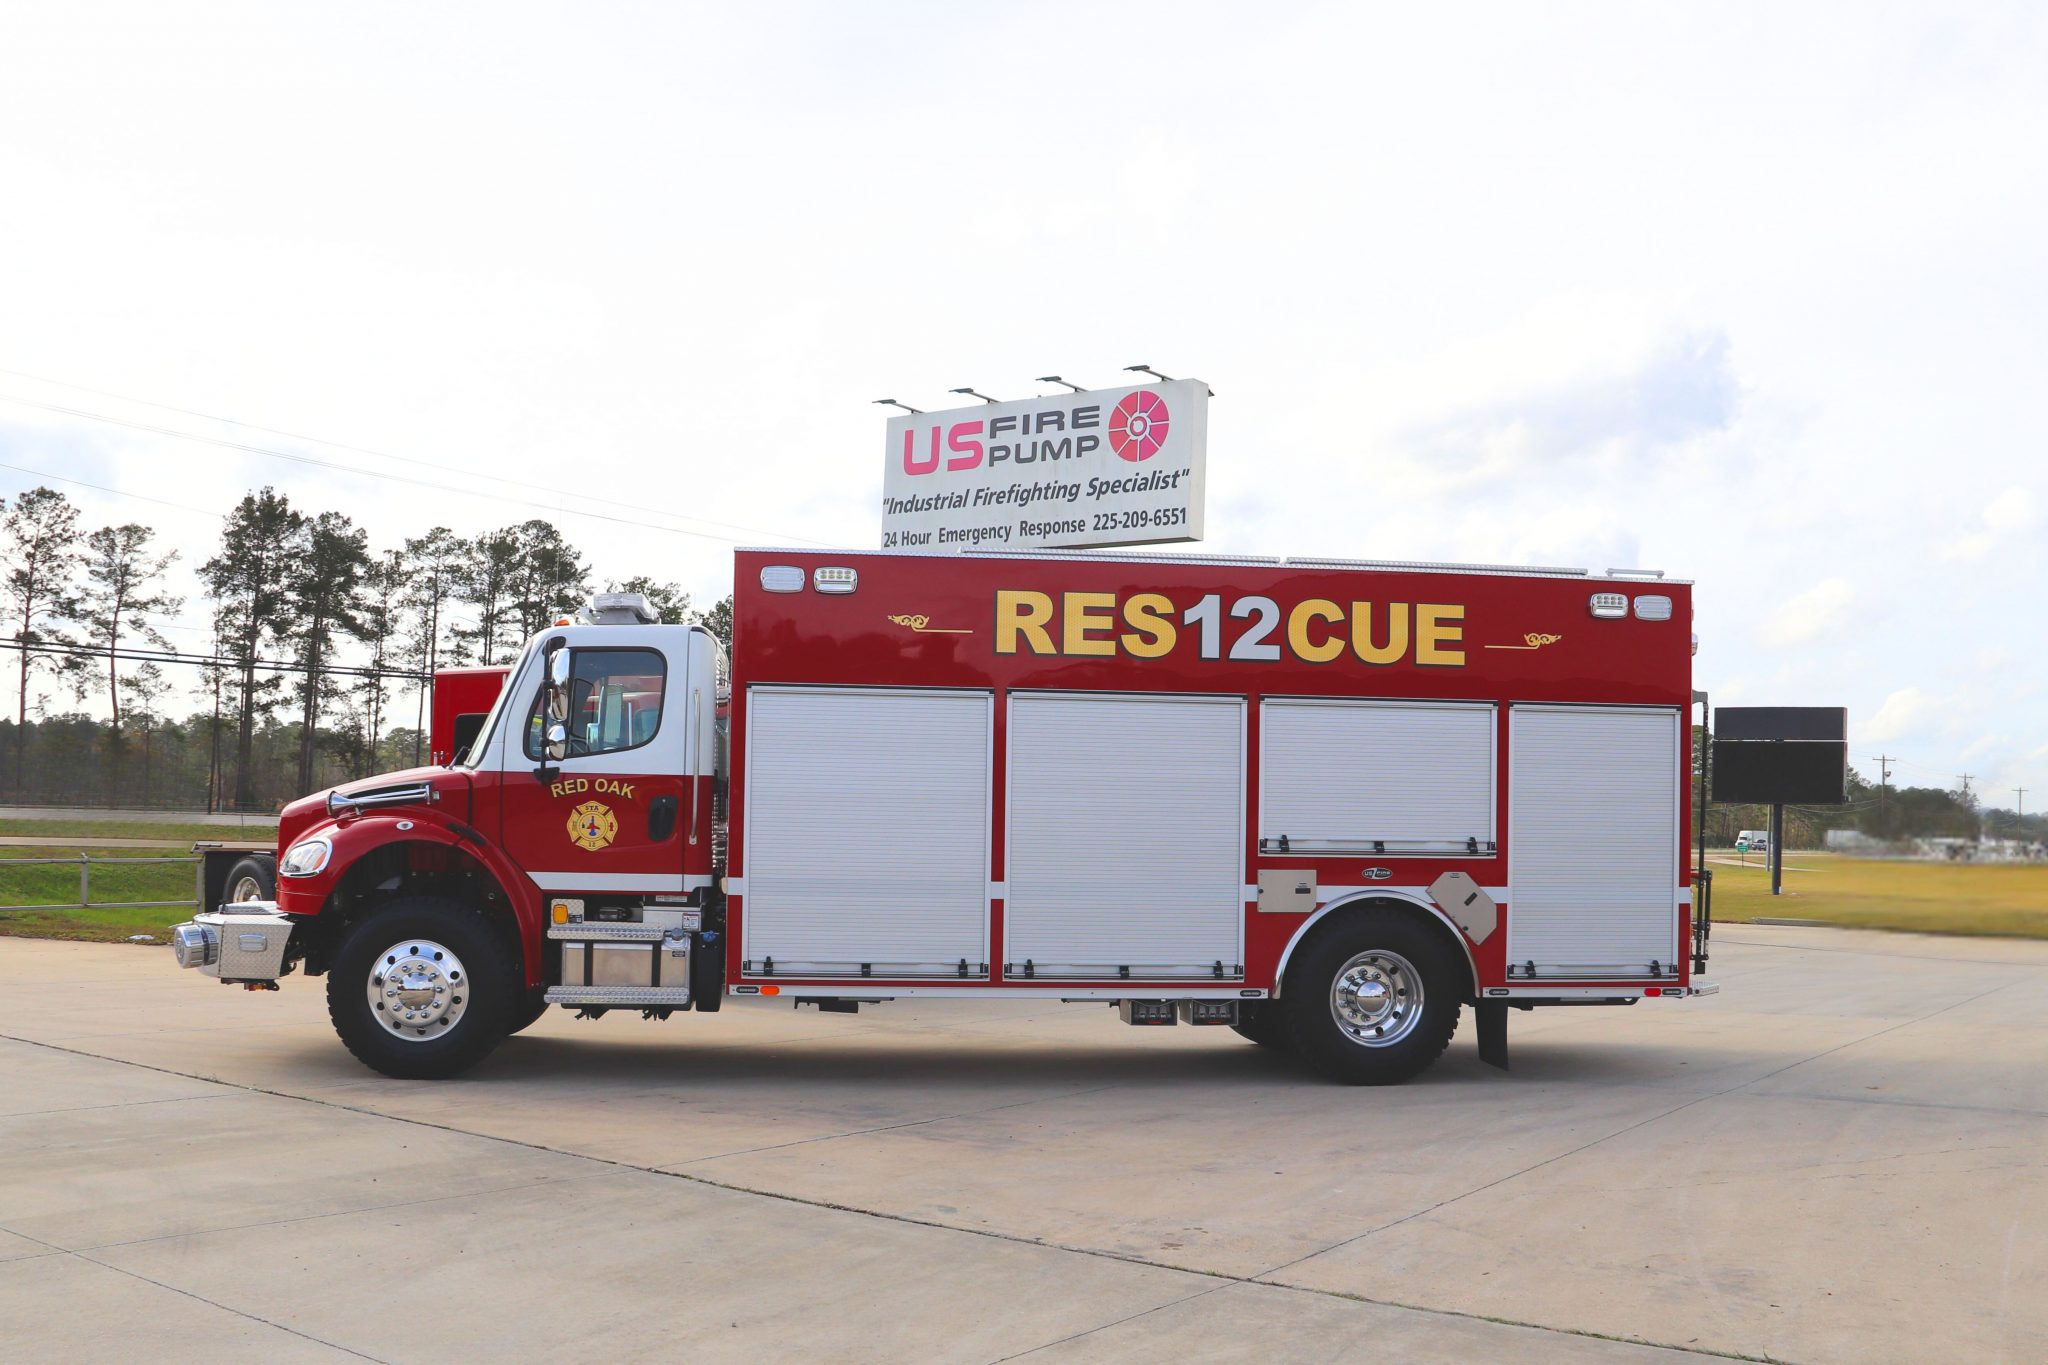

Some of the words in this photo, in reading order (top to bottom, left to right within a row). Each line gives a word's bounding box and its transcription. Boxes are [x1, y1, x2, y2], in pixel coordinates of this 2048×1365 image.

[989, 405, 1100, 439] FIRE
[903, 420, 984, 476] US
[988, 434, 1100, 467] PUMP
[972, 480, 1080, 508] Firefighting
[883, 531, 898, 548] 24
[901, 529, 932, 547] Hour
[938, 522, 1012, 545] Emergency
[1019, 517, 1086, 539] Response
[1093, 507, 1186, 531] 225-209-6551
[995, 589, 1466, 666] RES12CUE
[550, 778, 588, 798] RED
[594, 778, 636, 799] OAK
